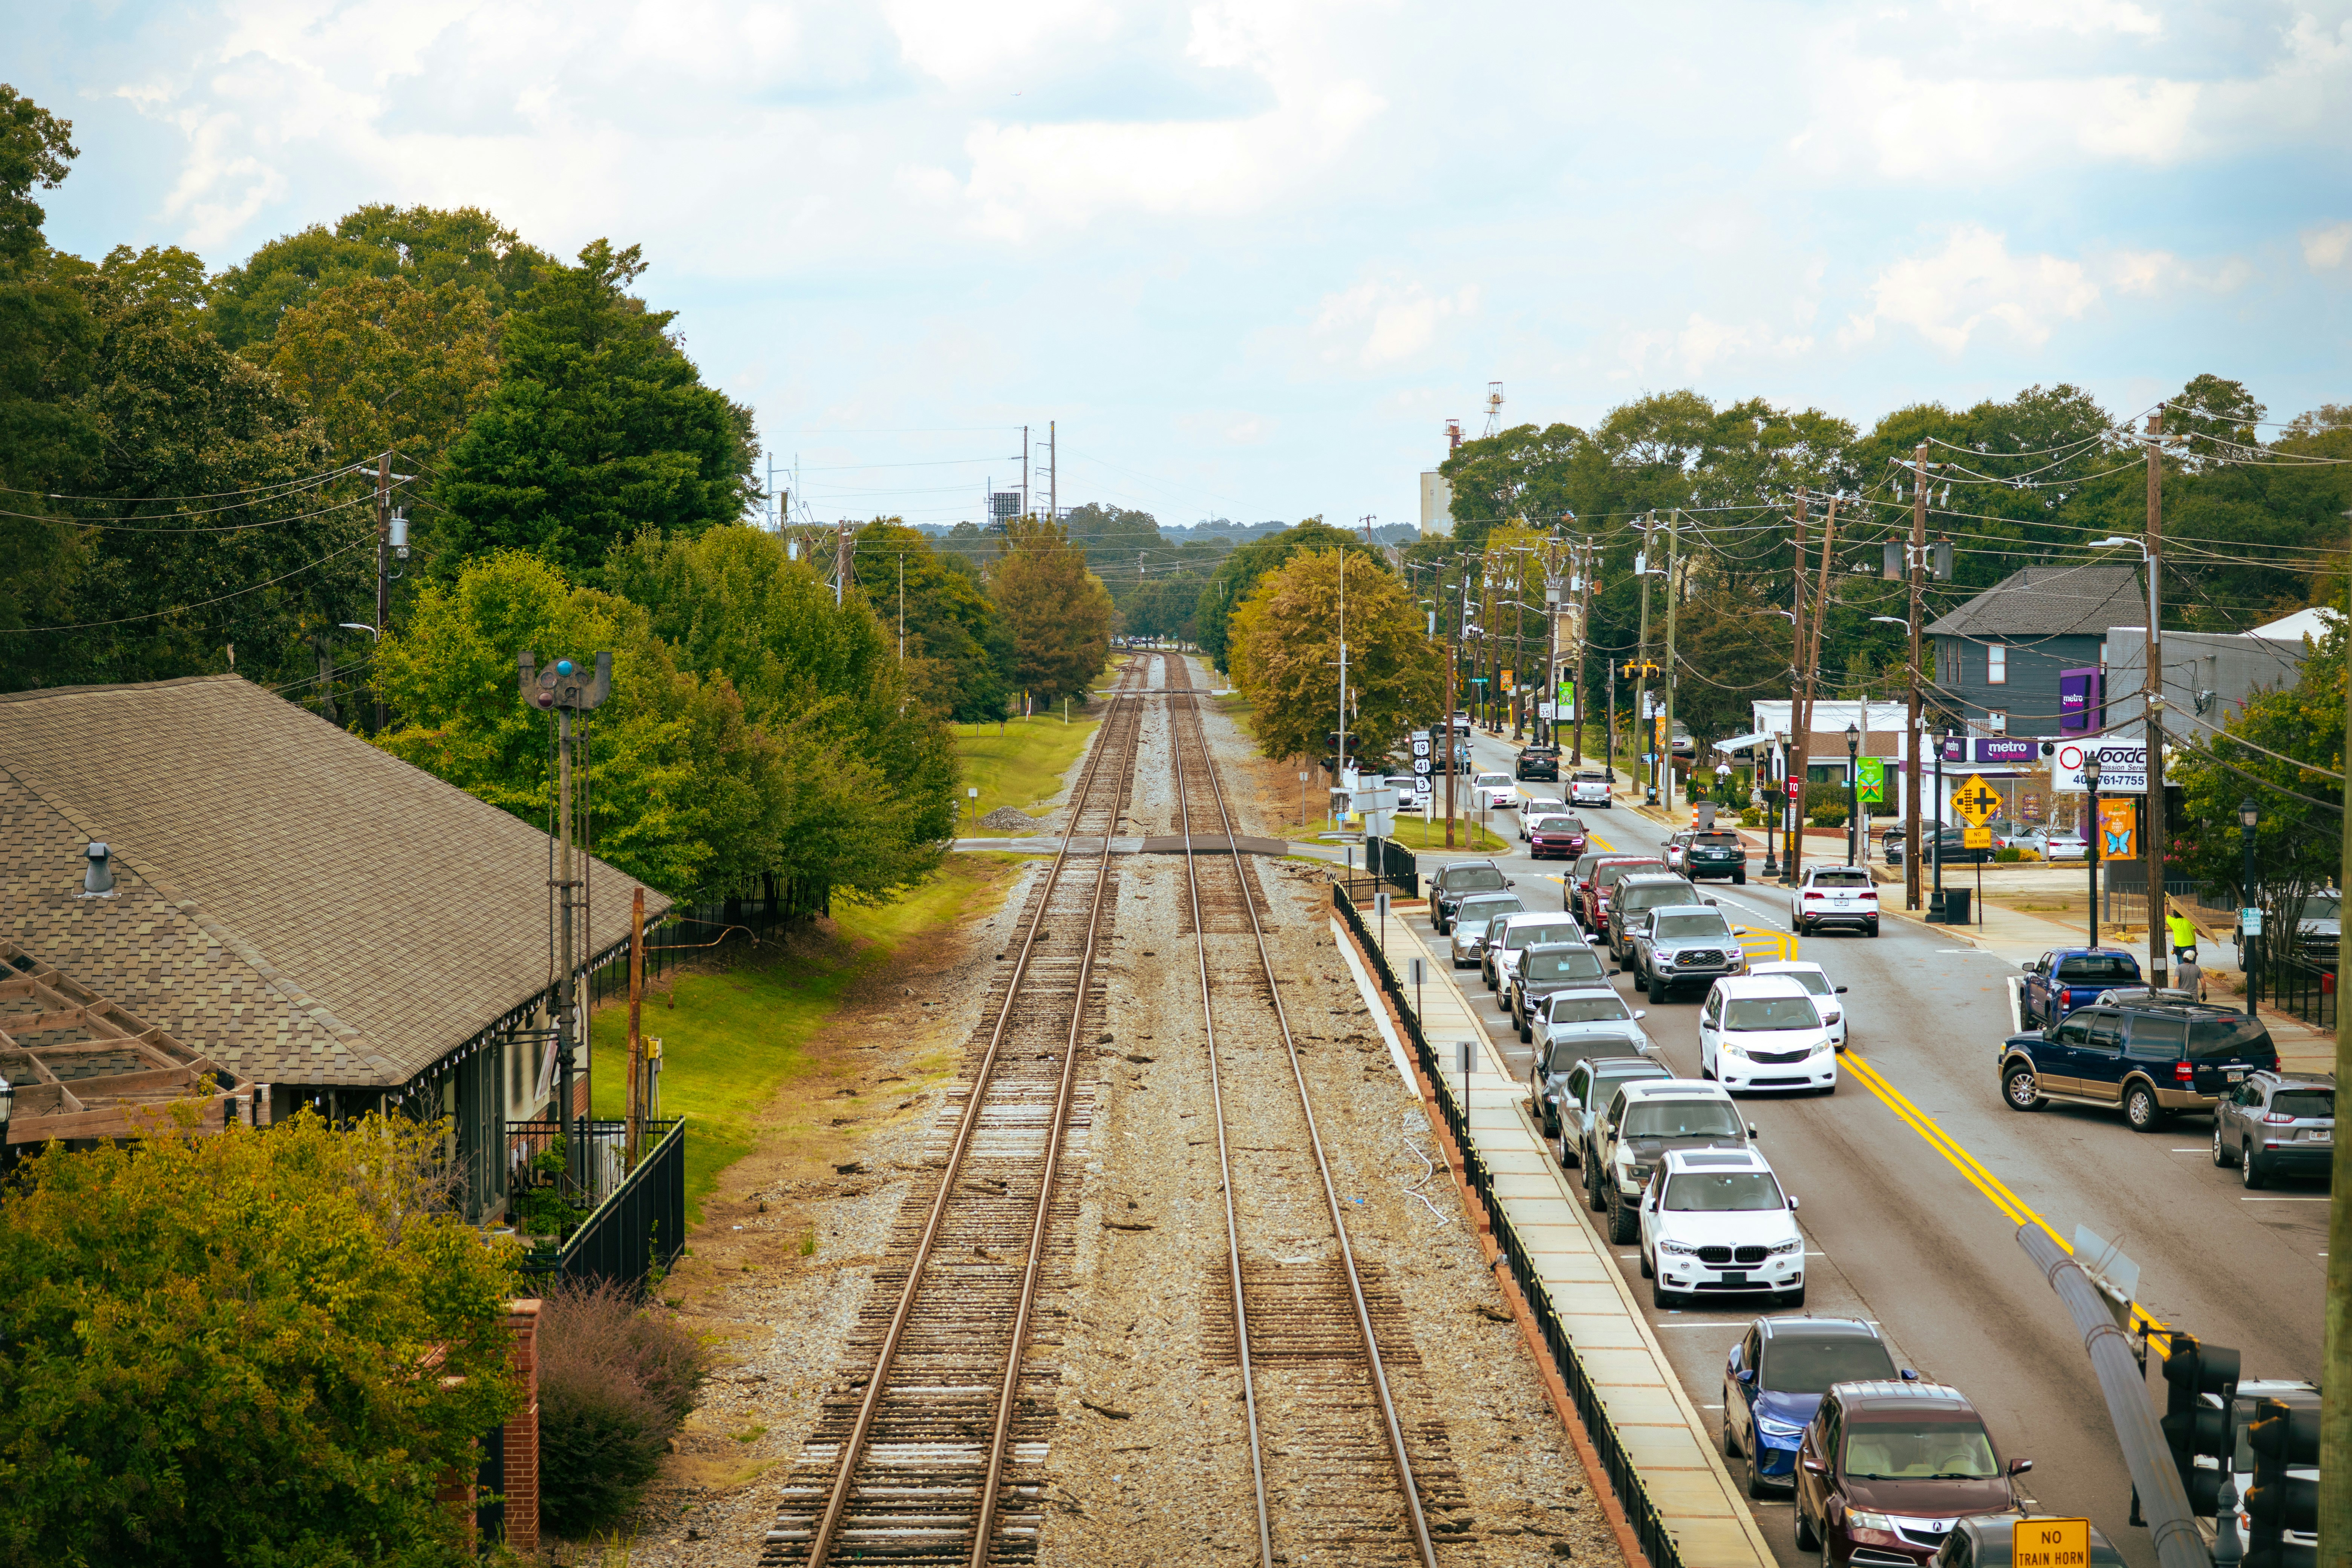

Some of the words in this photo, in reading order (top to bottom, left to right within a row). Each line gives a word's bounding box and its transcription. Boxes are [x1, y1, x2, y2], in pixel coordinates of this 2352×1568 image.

[2063, 694, 2083, 702] metro
[1417, 744, 1426, 753] 19
[1946, 741, 1959, 752] metro
[1988, 741, 2027, 752] metro
[1416, 762, 1427, 771] 41
[1419, 780, 1425, 789] 3
[1789, 782, 1798, 792] TO
[1326, 873, 1336, 882] W
[2041, 1531, 2061, 1544] NO
[2019, 1553, 2049, 1566] TRAIN
[2055, 1551, 2084, 1565] HORN
